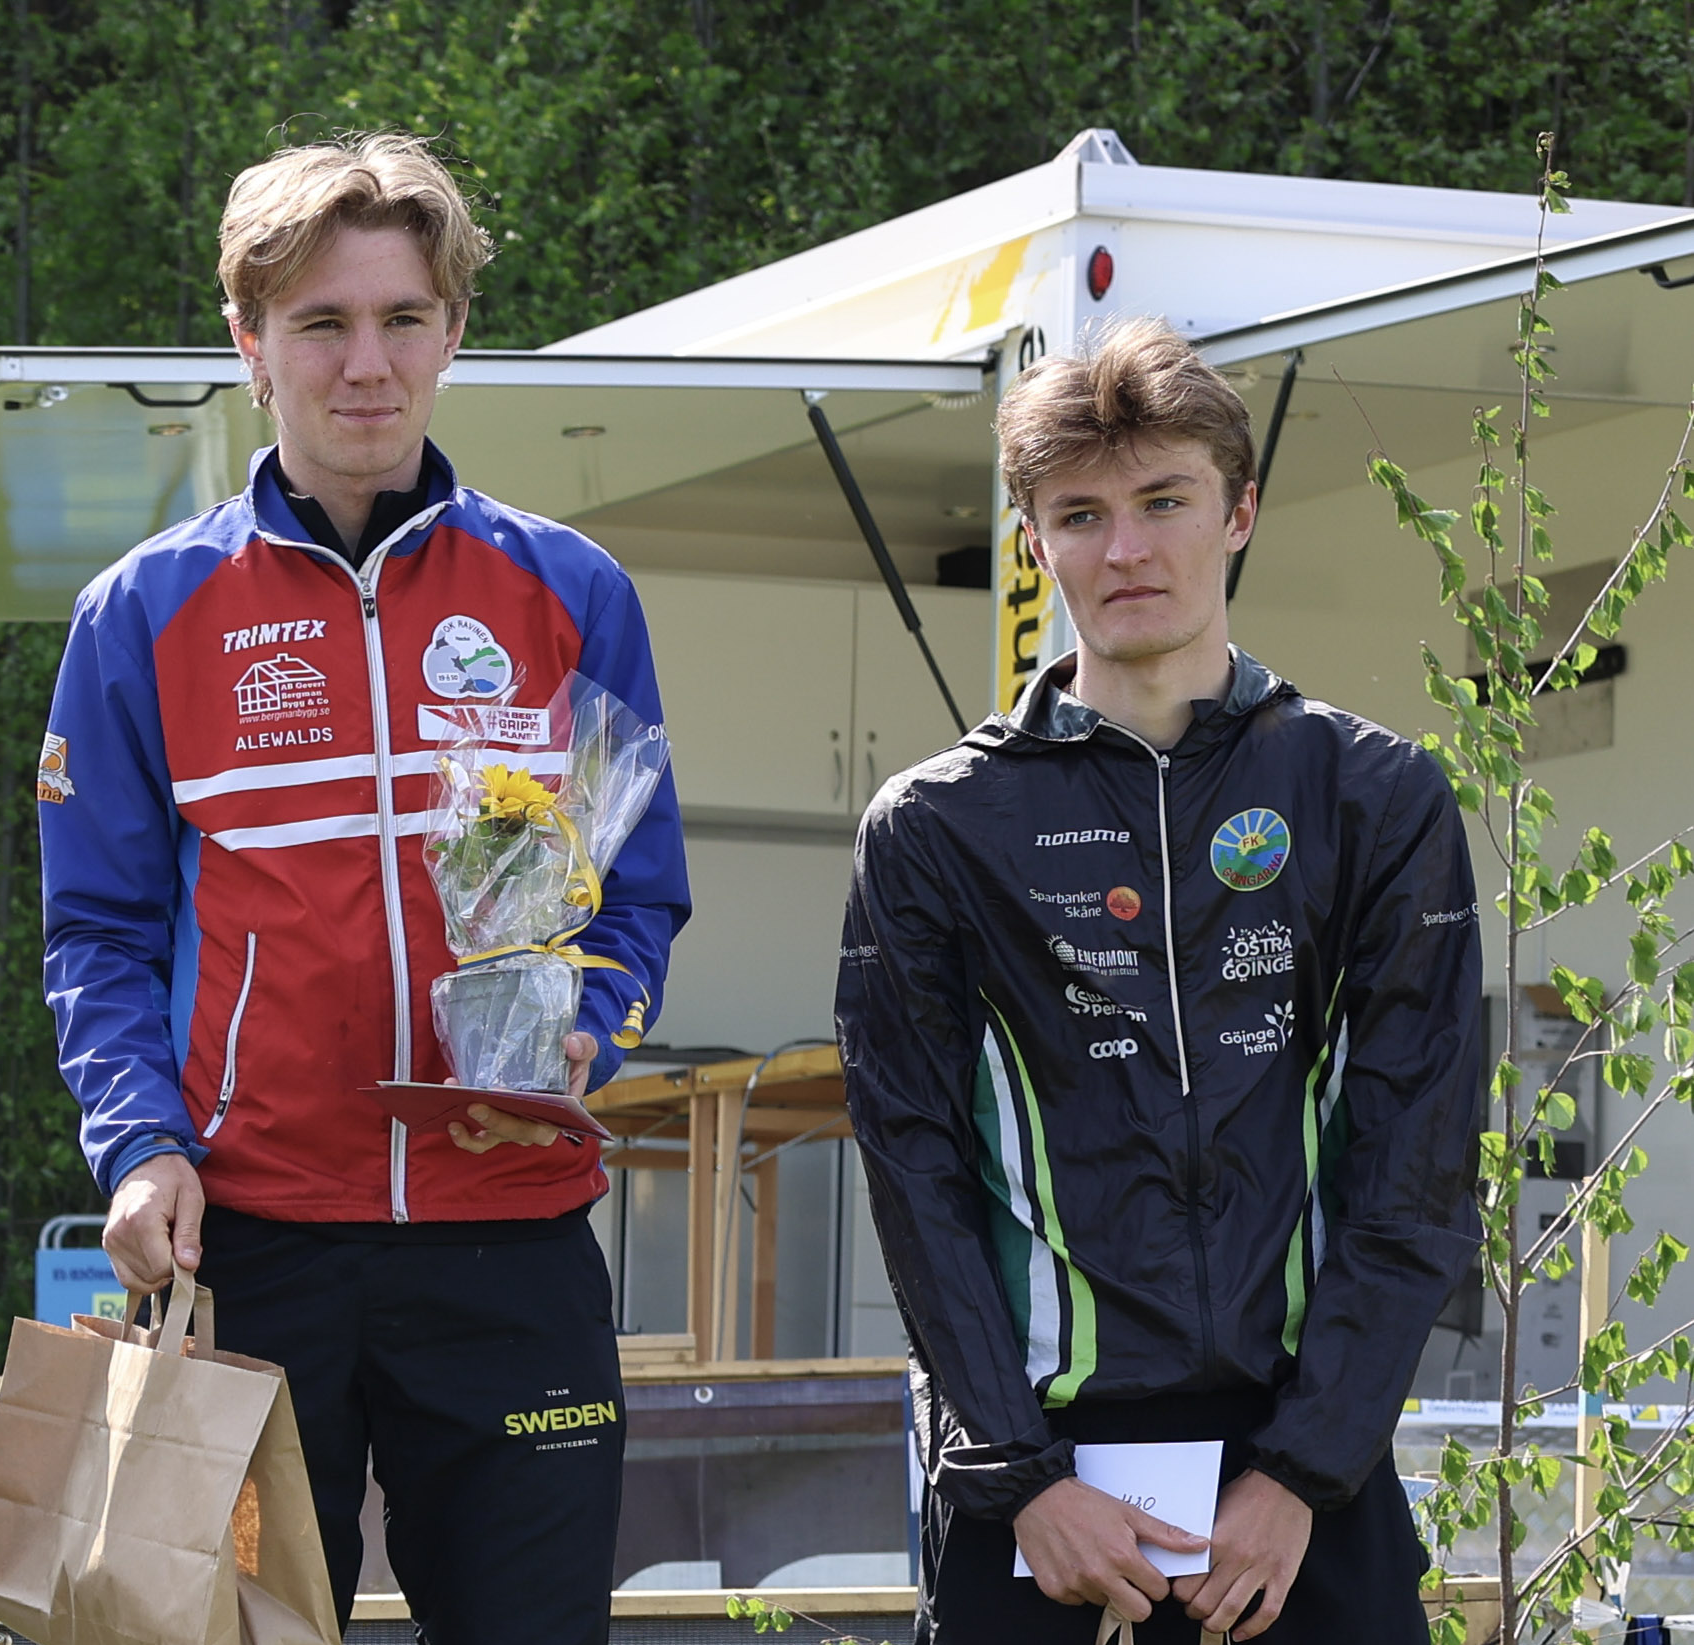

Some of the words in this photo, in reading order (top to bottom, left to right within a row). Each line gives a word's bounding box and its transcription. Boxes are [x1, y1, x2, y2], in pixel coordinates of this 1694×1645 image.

[222, 619, 327, 653] TRIMTEX
[457, 620, 490, 643] RAVINEN
[281, 690, 323, 700] Bergman
[239, 707, 331, 725] www.bergmanbygg.se
[235, 727, 333, 752] ALEWALDS
[1035, 829, 1130, 847] noname
[1242, 836, 1260, 848] FK
[1029, 888, 1101, 904] Sparbanken
[1064, 905, 1102, 918] Skåne
[1233, 934, 1292, 957] ÖSTRA
[1076, 949, 1139, 967] ENERMONT
[1219, 1029, 1276, 1044] Göinge
[1089, 1038, 1138, 1059] coop
[1243, 1042, 1278, 1056] hem
[545, 1388, 570, 1397] TEAM
[504, 1400, 617, 1435] SWEDEN
[535, 1438, 598, 1451] ORIENTERING
